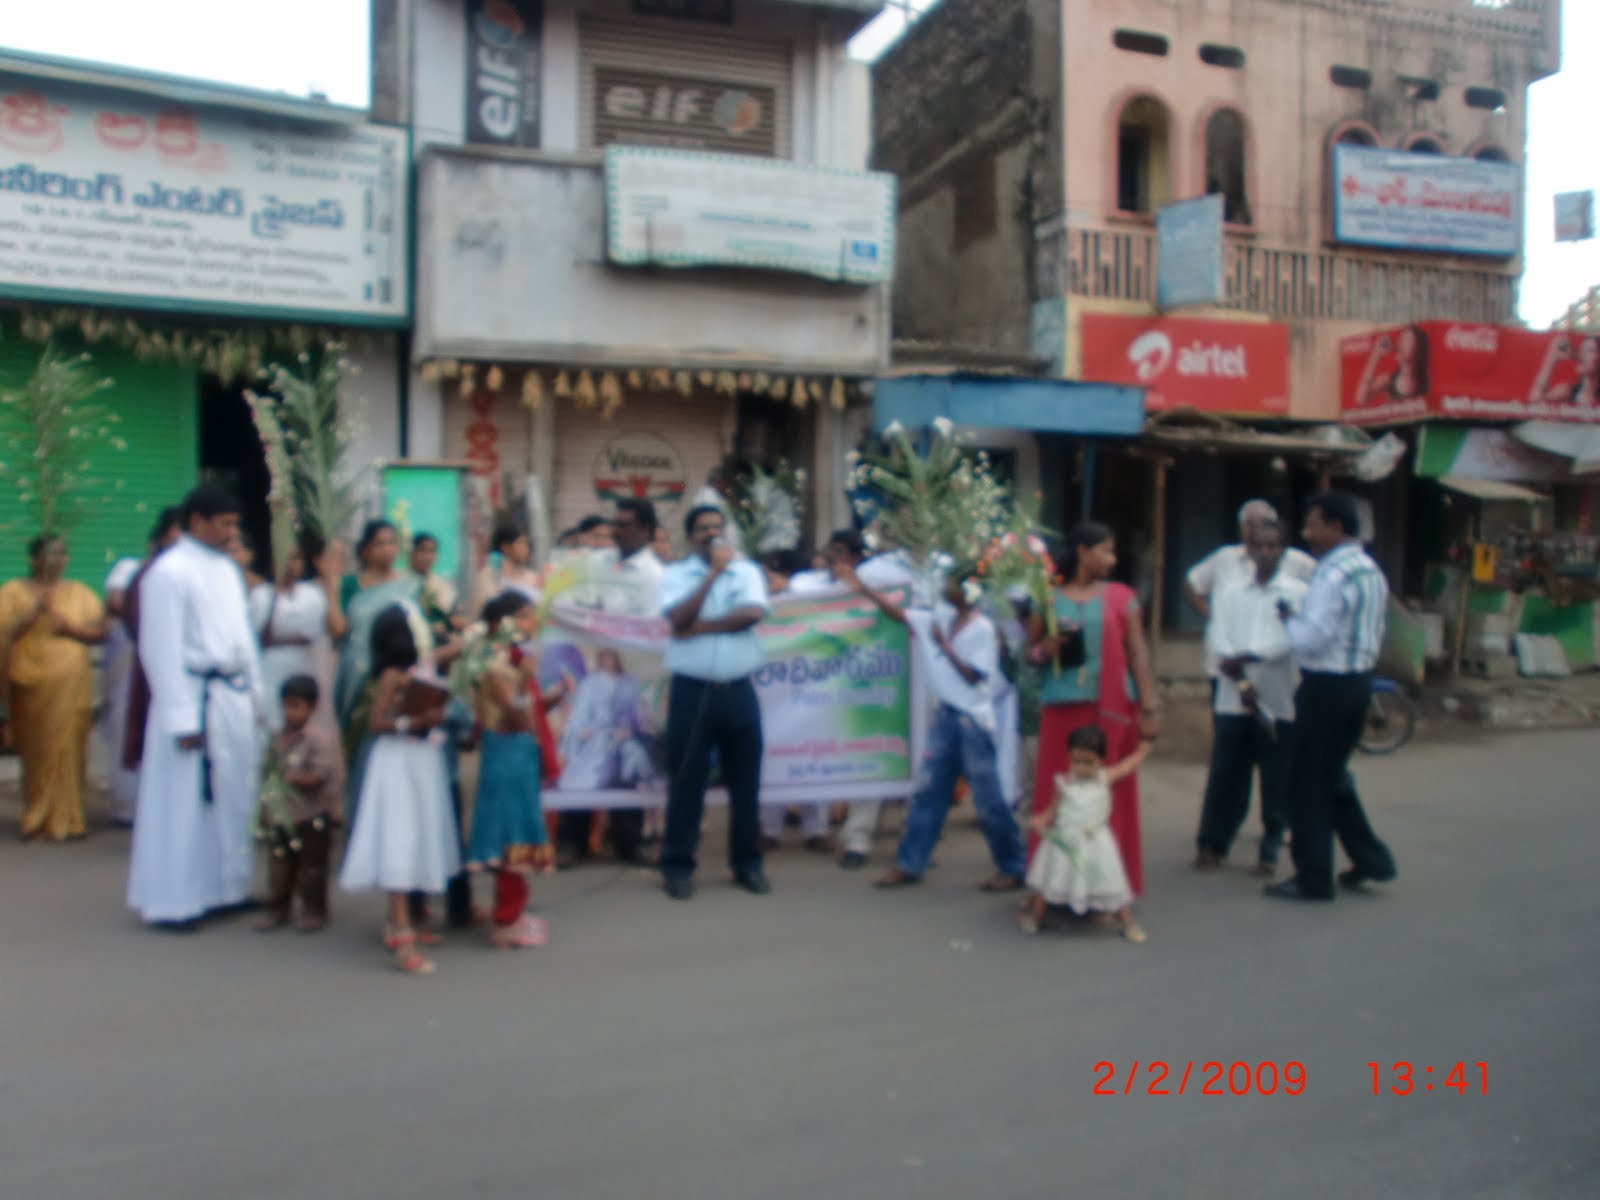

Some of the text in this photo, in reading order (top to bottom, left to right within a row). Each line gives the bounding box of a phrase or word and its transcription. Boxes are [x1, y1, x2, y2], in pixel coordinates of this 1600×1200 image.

[476, 44, 520, 139] elf
[604, 85, 703, 124] elf
[1175, 340, 1247, 379] airtel
